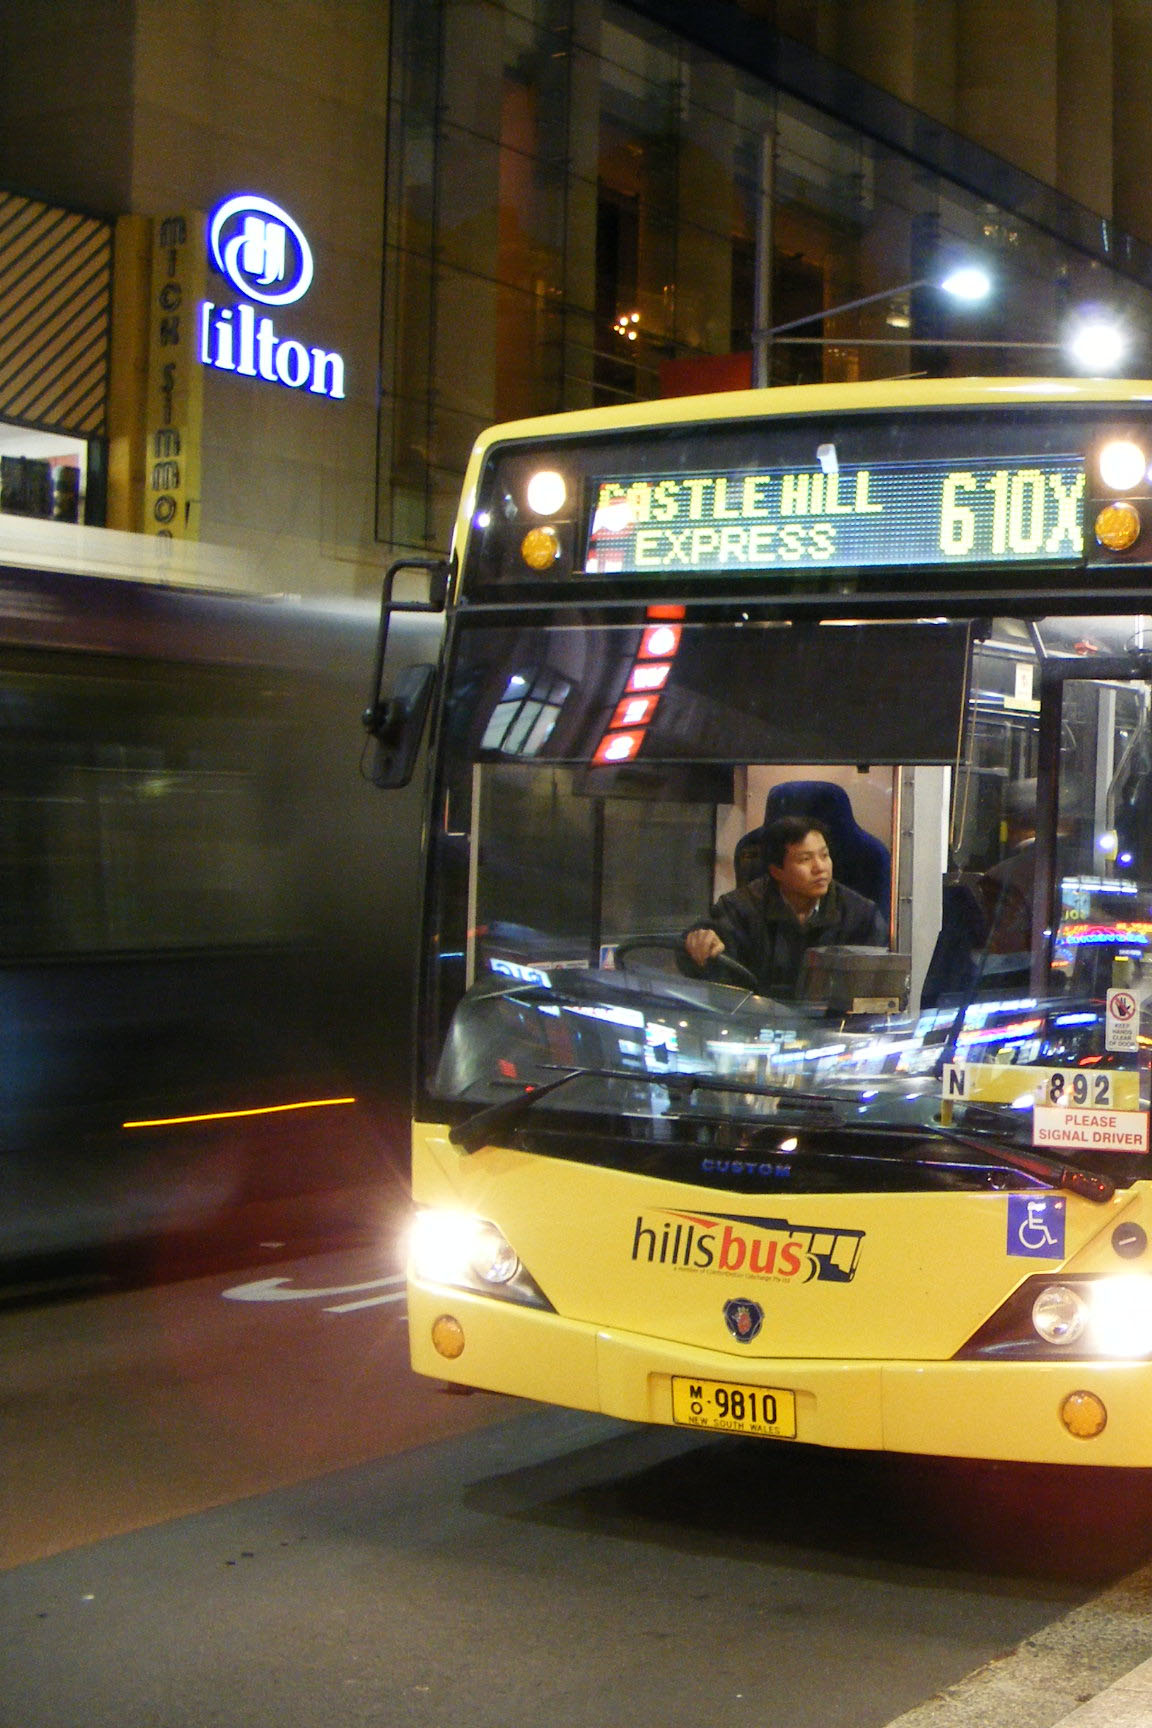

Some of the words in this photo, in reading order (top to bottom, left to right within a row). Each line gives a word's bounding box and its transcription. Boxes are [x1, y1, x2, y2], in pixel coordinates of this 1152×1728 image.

[781, 471, 883, 516] HILL
[939, 468, 1086, 556] 610X
[634, 523, 837, 566] EXPRESS
[949, 1068, 966, 1096] N
[1049, 1072, 1110, 1106] 892
[1039, 1128, 1088, 1142] SIGNAL
[1092, 1131, 1143, 1145] DRIVER
[1065, 1114, 1117, 1128] PLEASE
[632, 1216, 804, 1277] hillsbus
[714, 1388, 777, 1425] 9810
[688, 1415, 708, 1426] NEW
[713, 1418, 745, 1431] SOUTH
[749, 1423, 781, 1435] WALES
